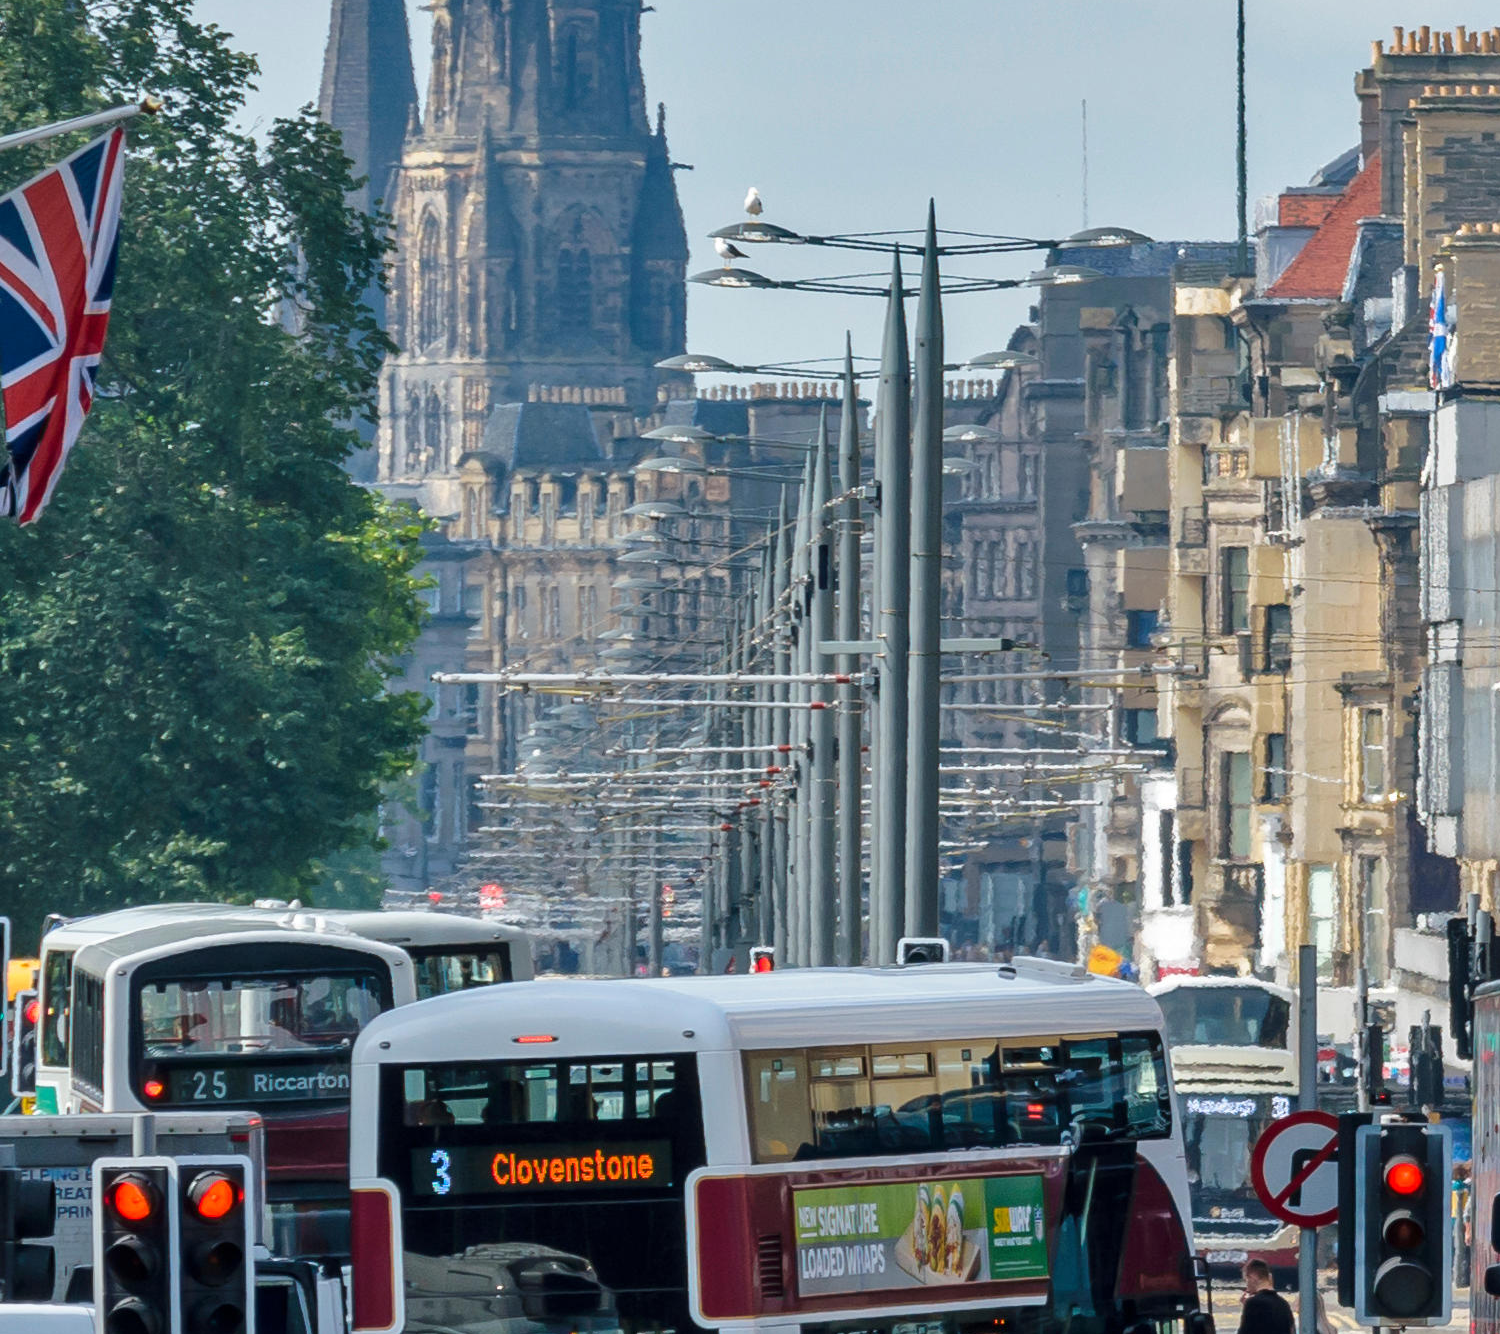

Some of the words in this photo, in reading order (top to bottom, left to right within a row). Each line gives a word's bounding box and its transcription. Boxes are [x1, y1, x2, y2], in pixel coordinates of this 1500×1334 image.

[193, 1071, 226, 1100] 25
[254, 1071, 349, 1093] Riccarton
[430, 1149, 451, 1196] 3
[492, 1151, 654, 1187] Clovenstone
[817, 1202, 879, 1236] SIGNATURE
[801, 1246, 845, 1279] LOADED
[848, 1243, 886, 1275] WRAPS
